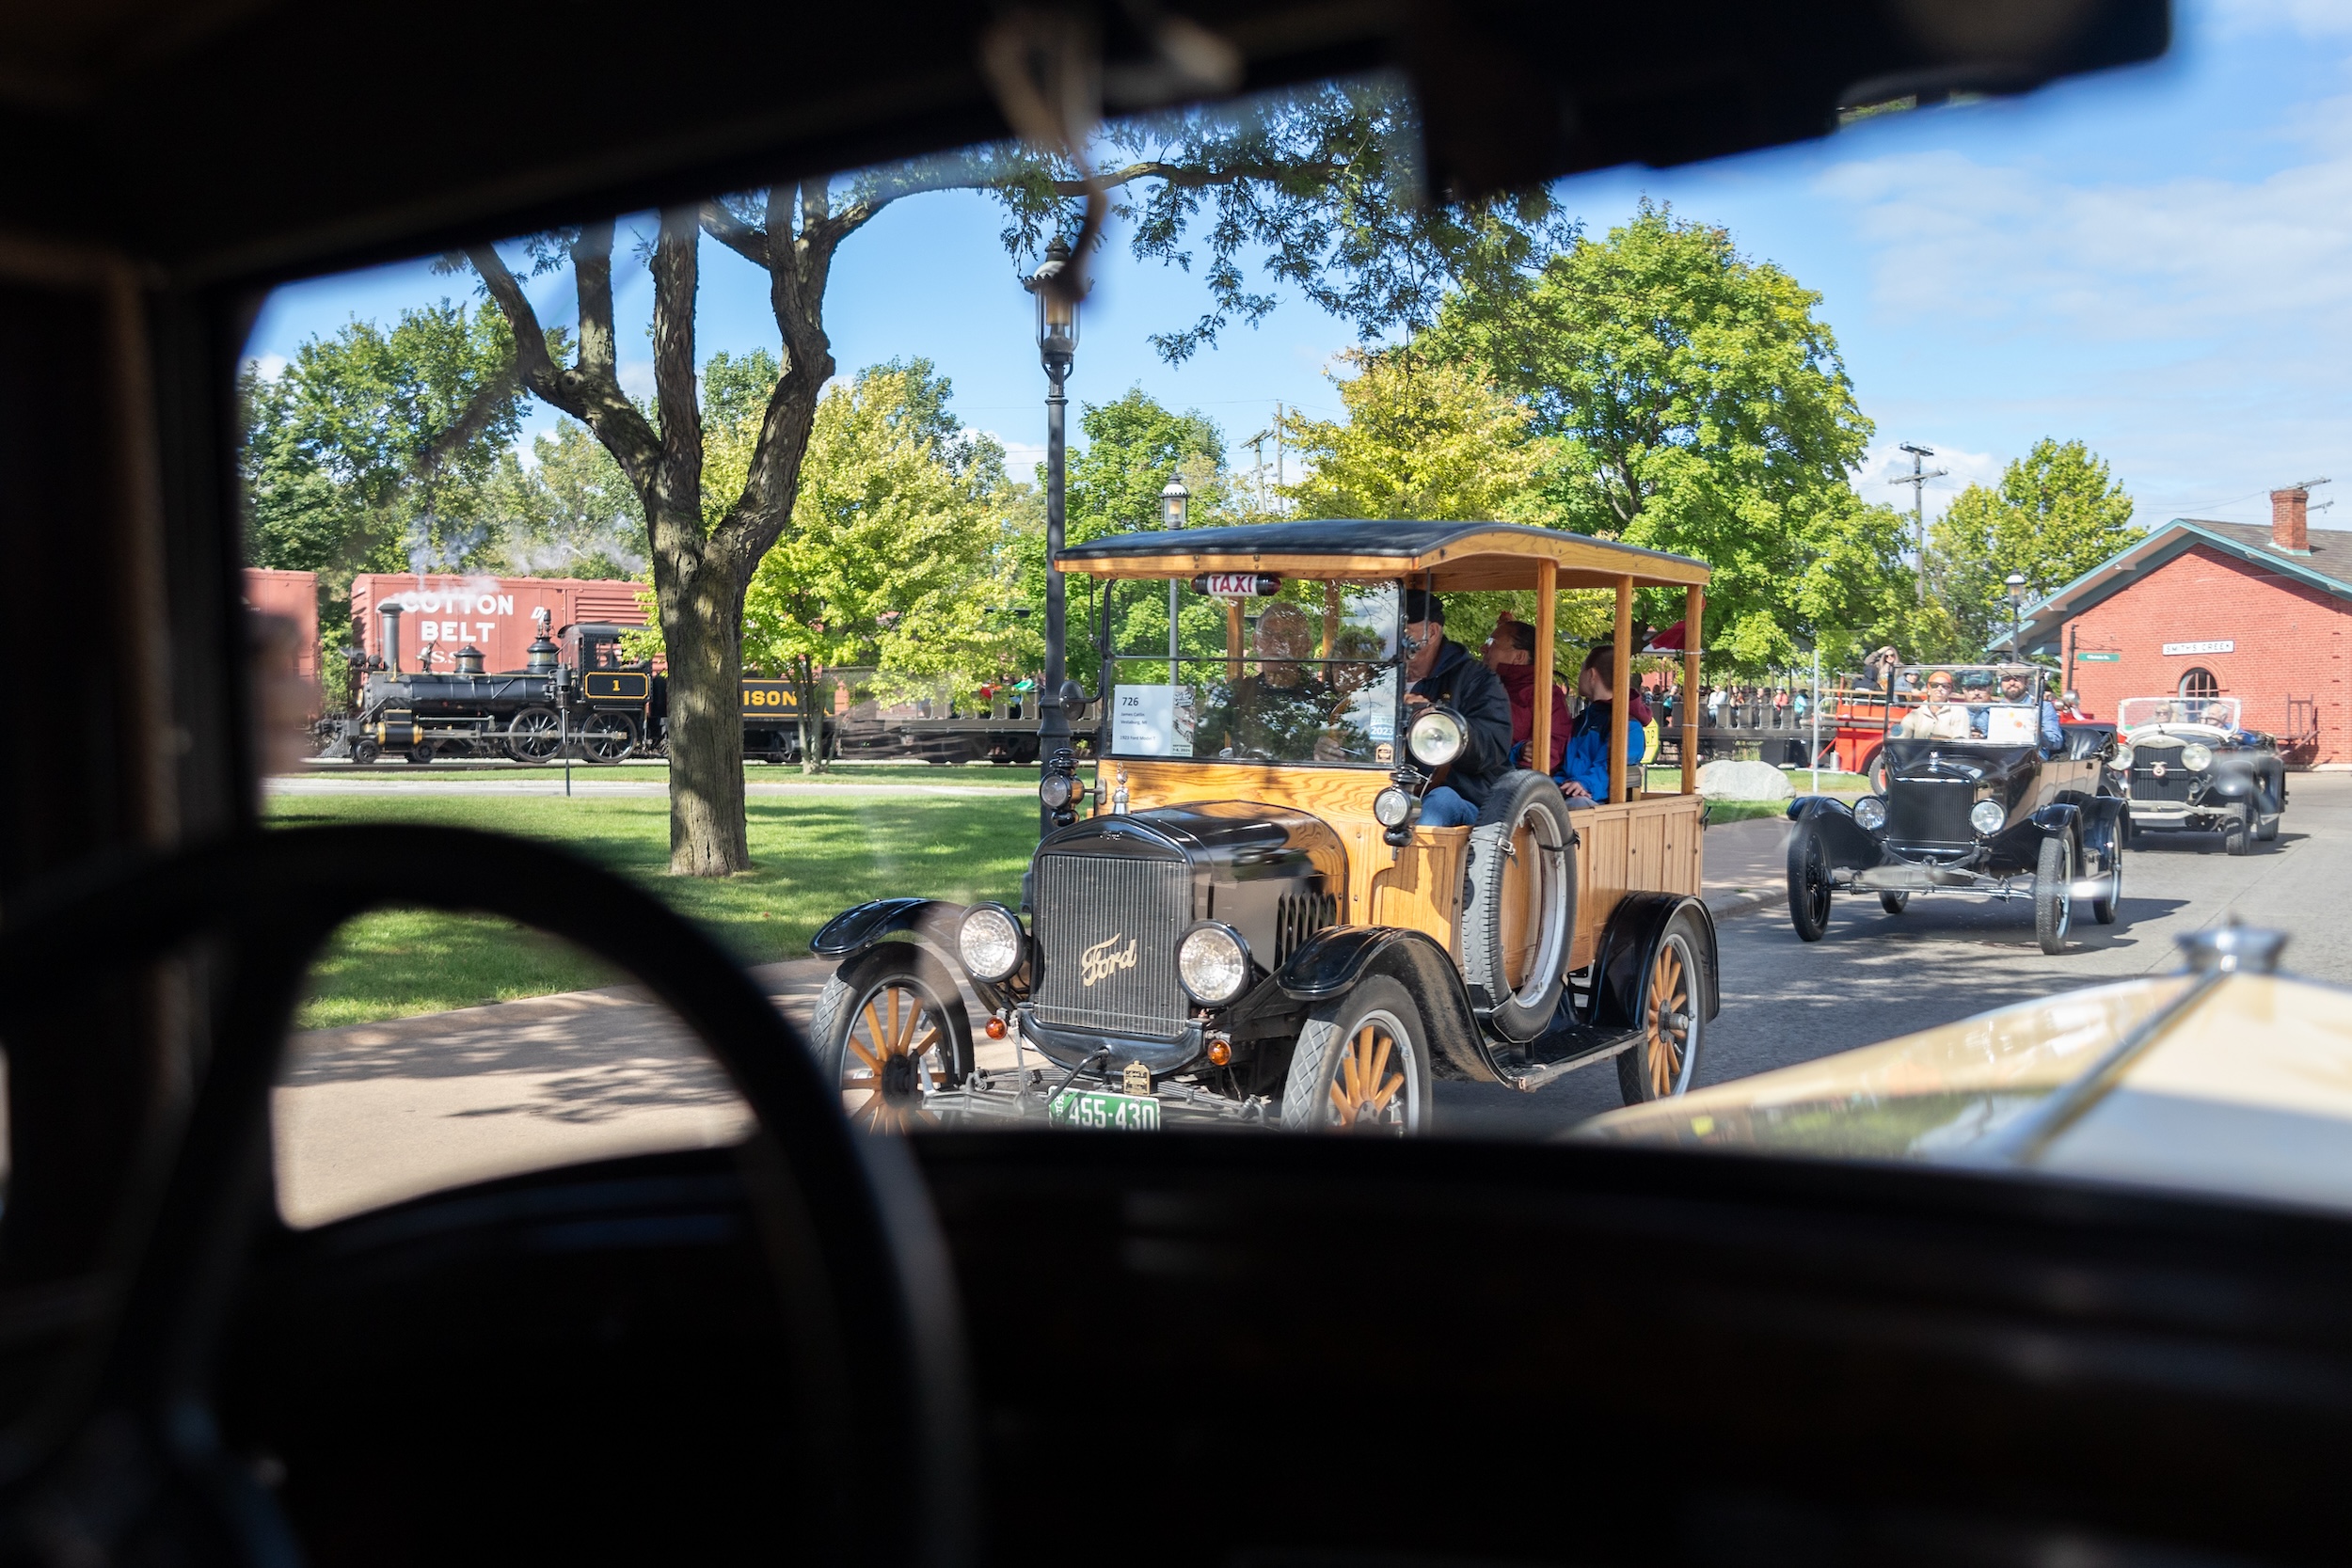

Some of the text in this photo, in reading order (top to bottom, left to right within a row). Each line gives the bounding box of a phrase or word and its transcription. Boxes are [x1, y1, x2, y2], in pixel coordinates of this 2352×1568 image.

[1211, 575, 1254, 594] TAXI
[401, 592, 514, 615] COTTON
[421, 621, 496, 642] BELT
[612, 679, 621, 692] 1
[742, 689, 798, 706] ISON
[1121, 697, 1139, 706] 726
[1370, 726, 1393, 736] 2023
[1081, 932, 1137, 987] Ford
[1069, 1096, 1156, 1130] 455-430
